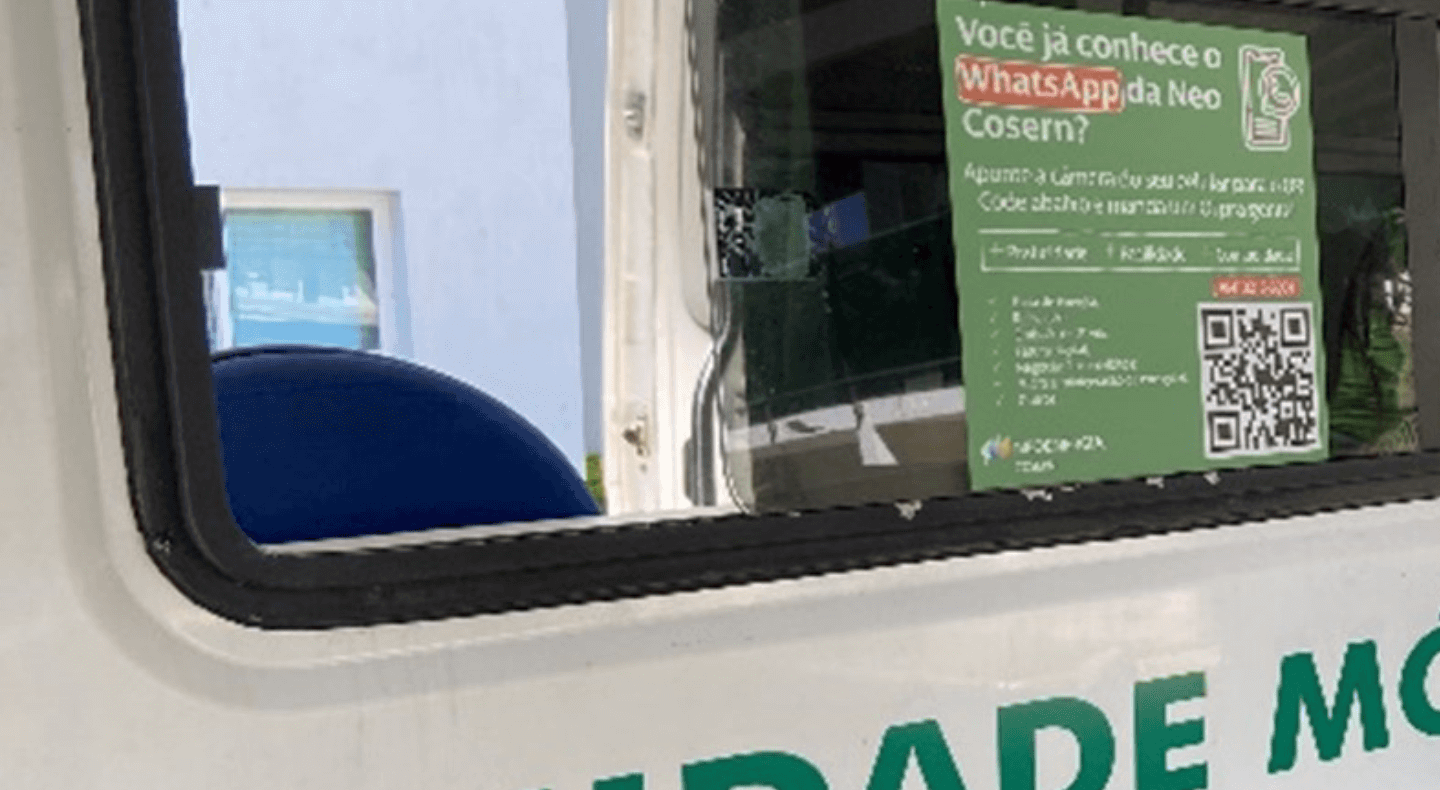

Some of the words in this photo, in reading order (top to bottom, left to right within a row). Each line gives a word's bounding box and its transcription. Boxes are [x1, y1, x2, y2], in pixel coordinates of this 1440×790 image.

[955, 15, 1035, 52] Você
[1041, 22, 1070, 61] já
[1076, 32, 1199, 67] conhece
[1203, 47, 1221, 69] o
[959, 61, 1119, 110] WhatsApp
[1127, 75, 1161, 107] da
[1168, 79, 1222, 110] Neo
[962, 107, 1091, 144] Cosern?
